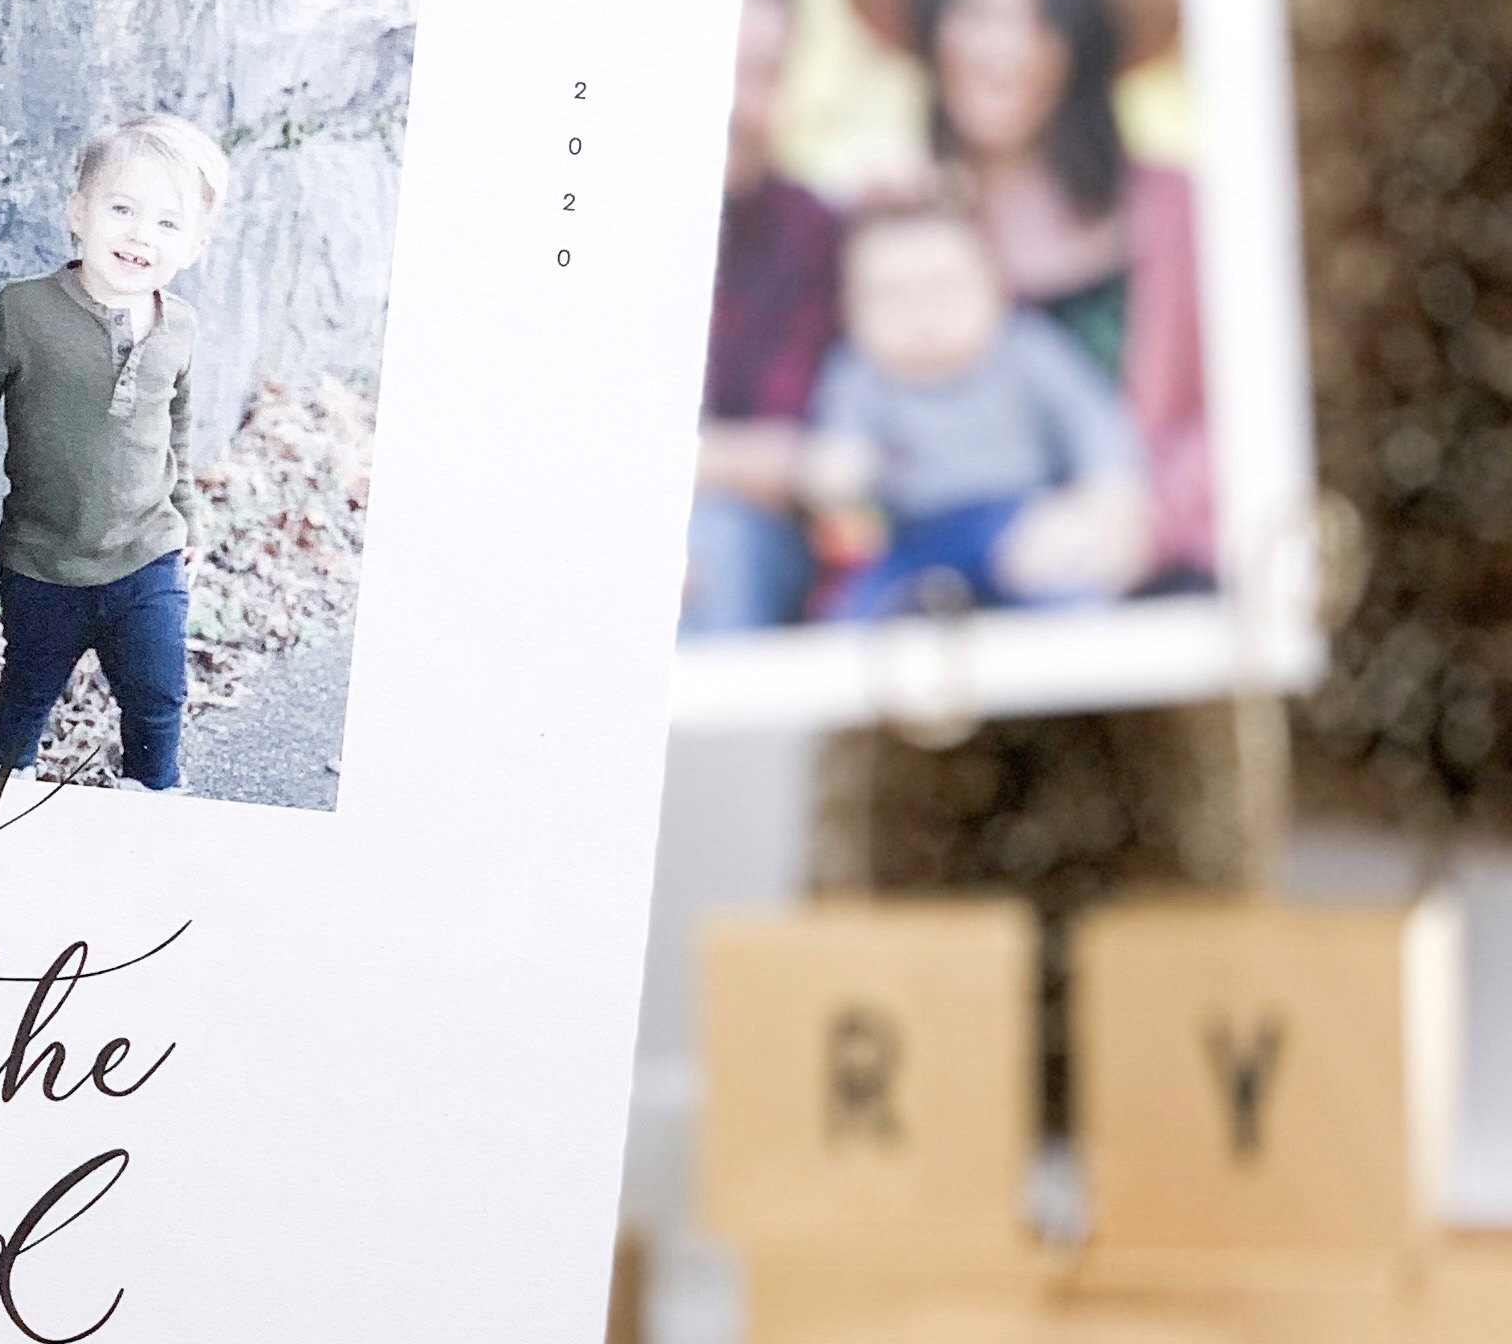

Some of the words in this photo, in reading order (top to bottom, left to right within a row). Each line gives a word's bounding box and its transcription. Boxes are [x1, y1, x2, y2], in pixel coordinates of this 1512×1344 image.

[555, 80, 588, 268] 2020
[823, 1000, 908, 1160] R
[1194, 1006, 1286, 1168] Y
